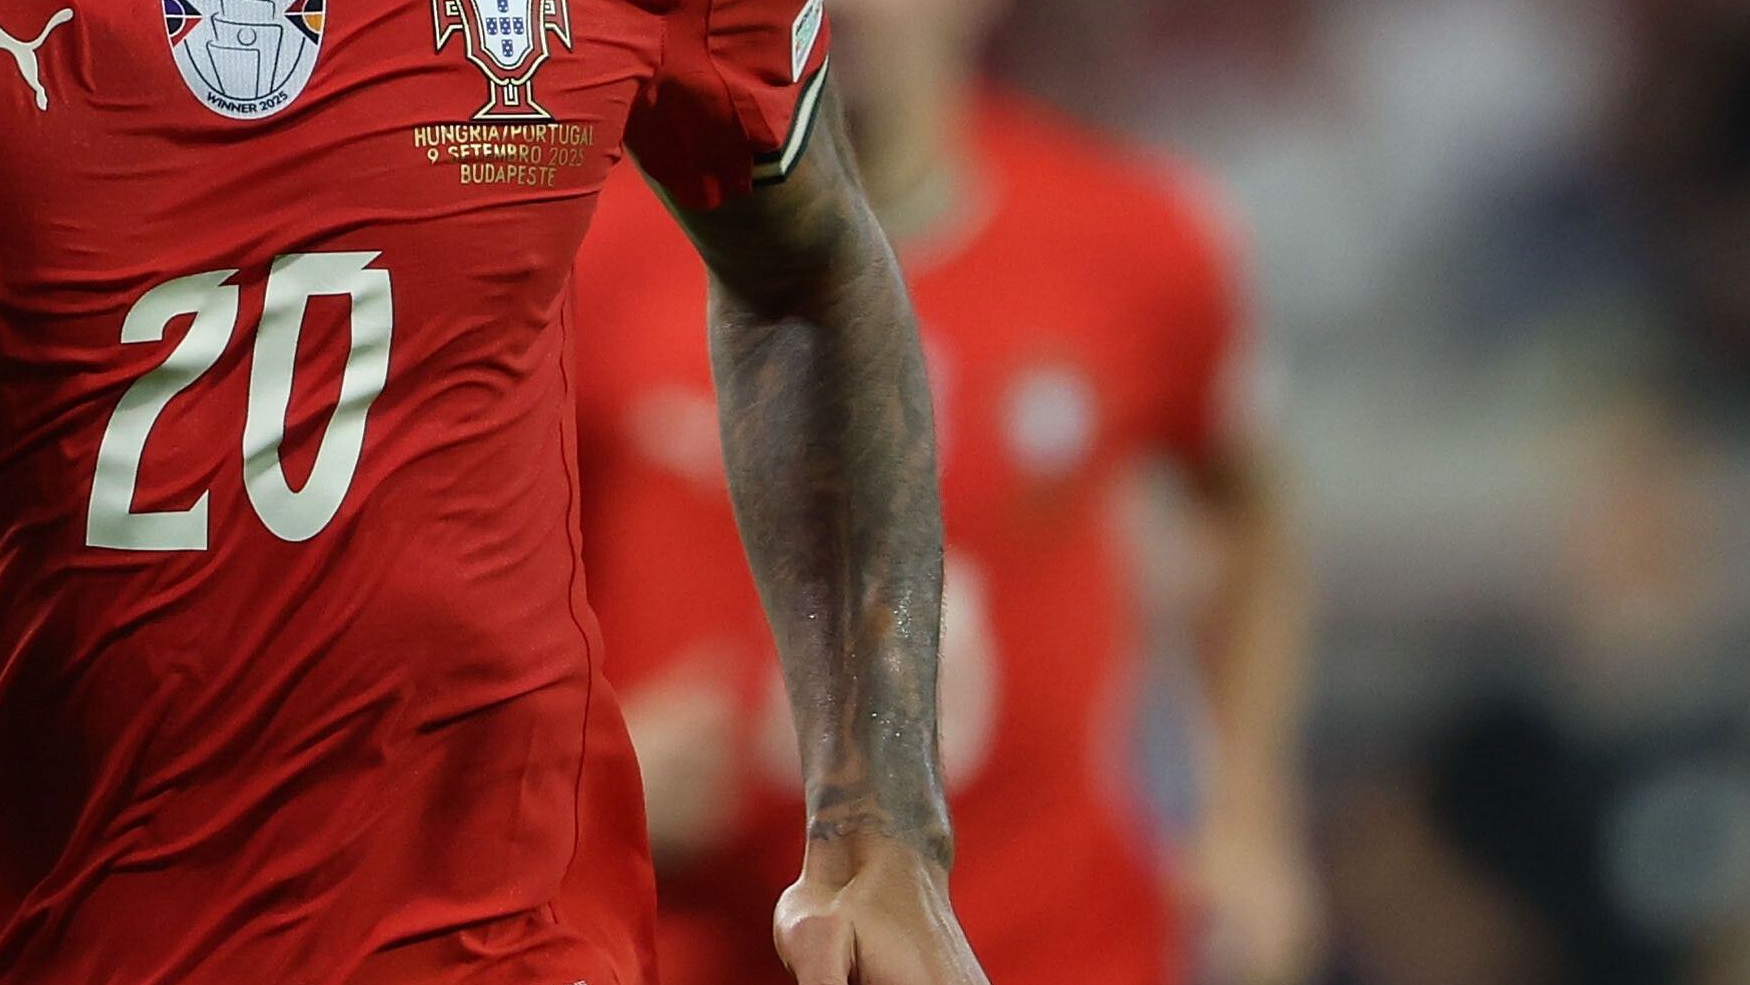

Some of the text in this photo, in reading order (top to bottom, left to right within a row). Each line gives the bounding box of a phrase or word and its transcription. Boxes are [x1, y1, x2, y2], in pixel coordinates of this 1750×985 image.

[206, 91, 289, 113] WINNER 2025
[427, 147, 440, 166] 9
[447, 143, 542, 164] SETEMBRO
[460, 163, 557, 187] BUDAPESTE
[86, 251, 393, 551] 20
